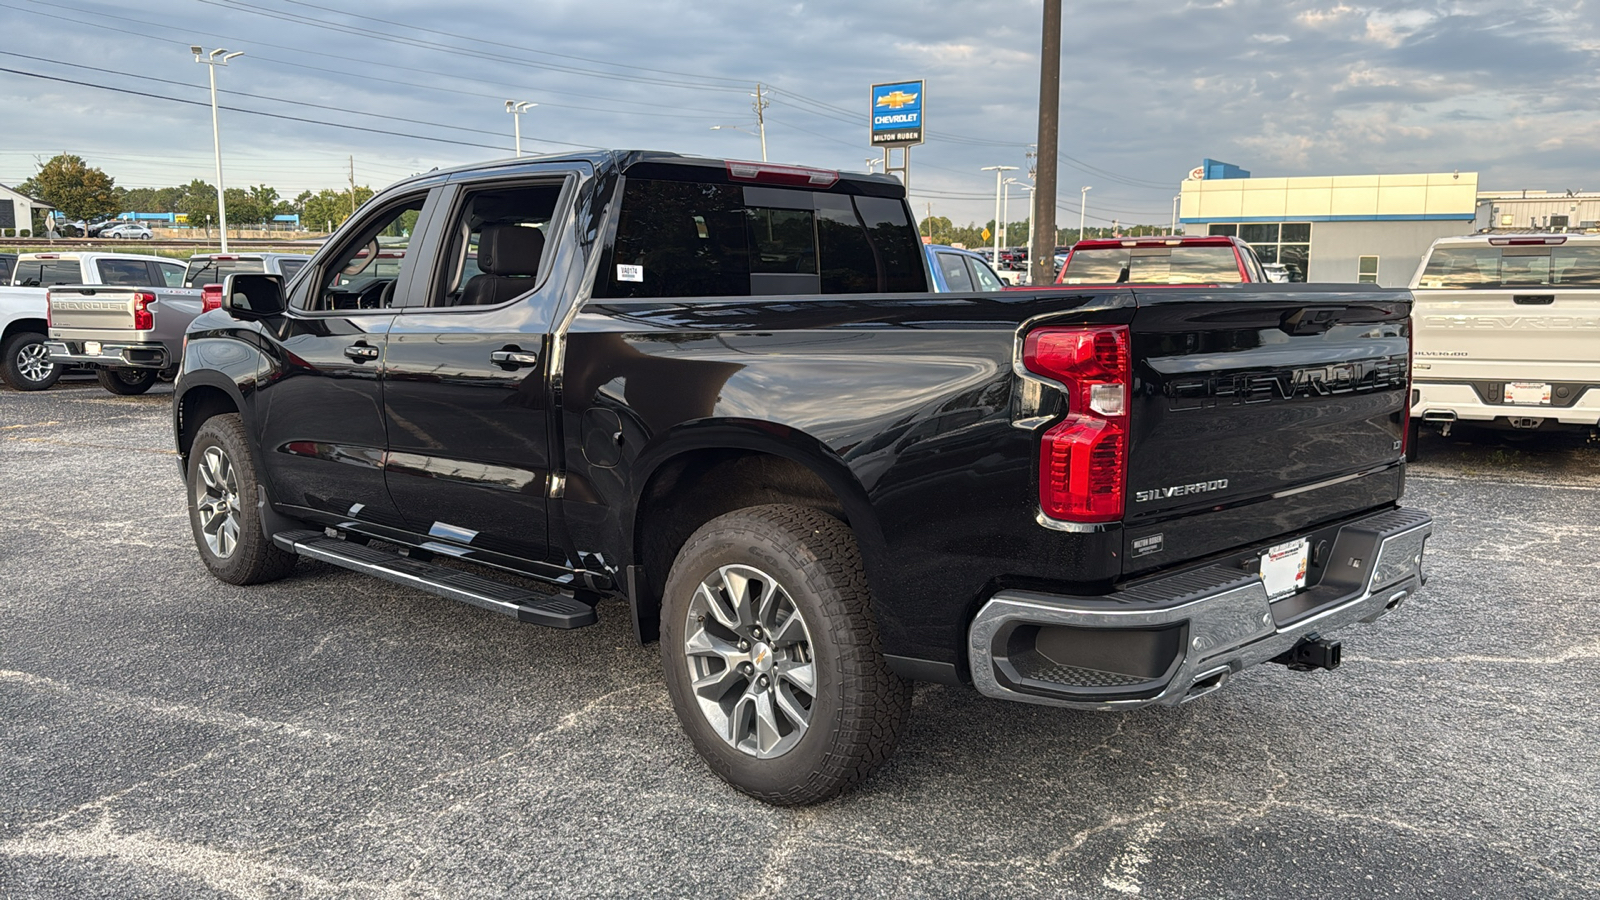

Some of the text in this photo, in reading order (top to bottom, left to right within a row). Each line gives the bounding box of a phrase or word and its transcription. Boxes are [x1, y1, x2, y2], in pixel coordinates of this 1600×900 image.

[875, 113, 918, 125] CHEVROLET
[874, 132, 919, 142] MILTON RUBEN
[52, 301, 128, 311] CHEVROLET
[1425, 316, 1600, 329] CHEVROL
[1163, 356, 1408, 412] CHEVROLET
[1136, 479, 1229, 503] SILVERADO
